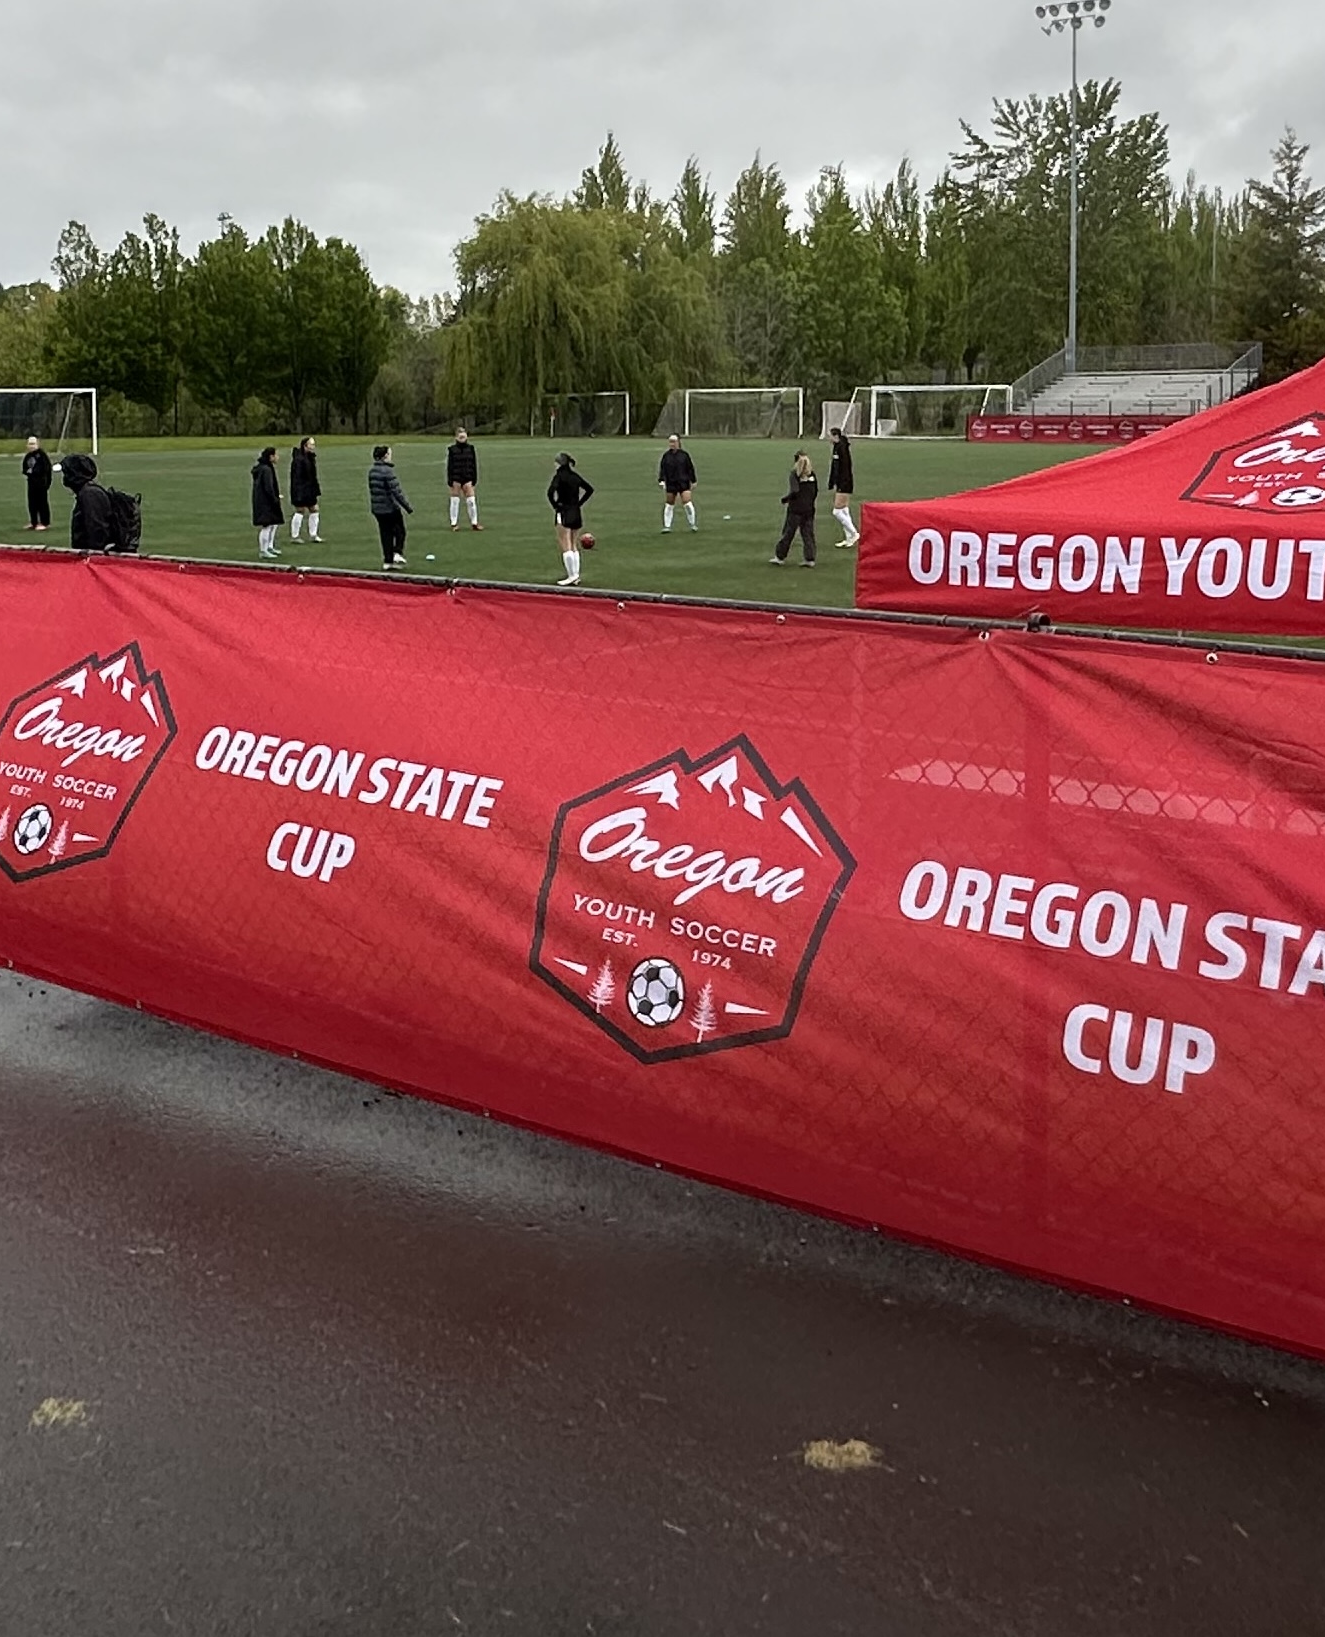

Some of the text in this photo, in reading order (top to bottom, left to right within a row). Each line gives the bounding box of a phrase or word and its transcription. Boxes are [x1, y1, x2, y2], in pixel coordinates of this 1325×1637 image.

[908, 528, 1145, 594] OREGON
[13, 697, 146, 766] Oregon
[52, 774, 117, 800] SOCCER
[196, 725, 503, 828] OREGON STATE
[266, 822, 355, 883] CUP
[578, 807, 804, 905] Oregon
[573, 894, 776, 957] YOUTH SOCCER
[899, 860, 1188, 970] OREGON
[602, 928, 731, 970] EST. 1974
[1062, 1003, 1216, 1094] CUP
